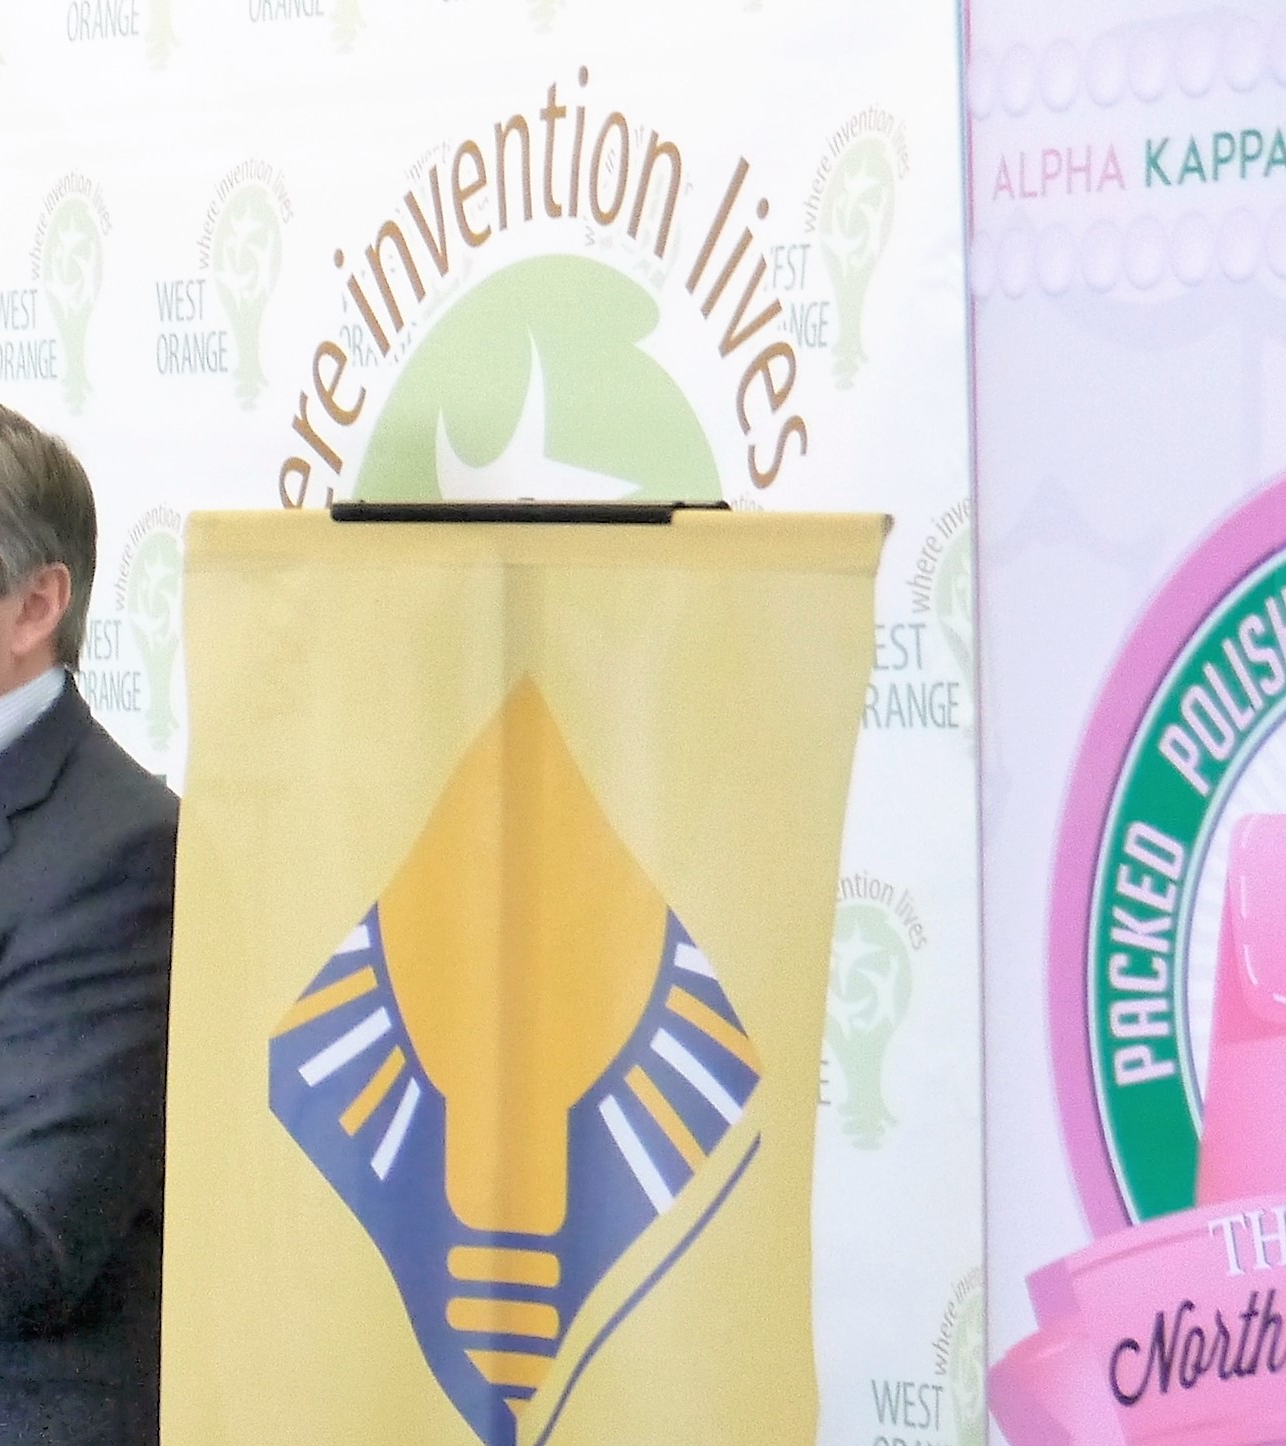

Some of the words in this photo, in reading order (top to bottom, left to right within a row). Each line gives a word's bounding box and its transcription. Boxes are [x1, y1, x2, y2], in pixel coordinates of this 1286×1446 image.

[65, 0, 141, 43] ORANGE
[803, 155, 831, 234] where
[826, 102, 895, 158] invention
[992, 143, 1127, 202] ALPHA
[196, 201, 220, 271] where
[214, 155, 274, 204] invention
[155, 279, 207, 323] WEST
[277, 340, 369, 511] ere
[333, 63, 684, 357] invention
[684, 155, 810, 490] lives
[155, 331, 228, 376] ORANGE
[114, 543, 134, 612] where
[906, 534, 946, 615] where
[873, 623, 927, 671] EST
[862, 681, 960, 729] RANGE
[1106, 820, 1186, 1088] PACKED
[932, 1300, 959, 1376] where
[1108, 1288, 1286, 1408] North
[870, 1378, 944, 1432] WEST
